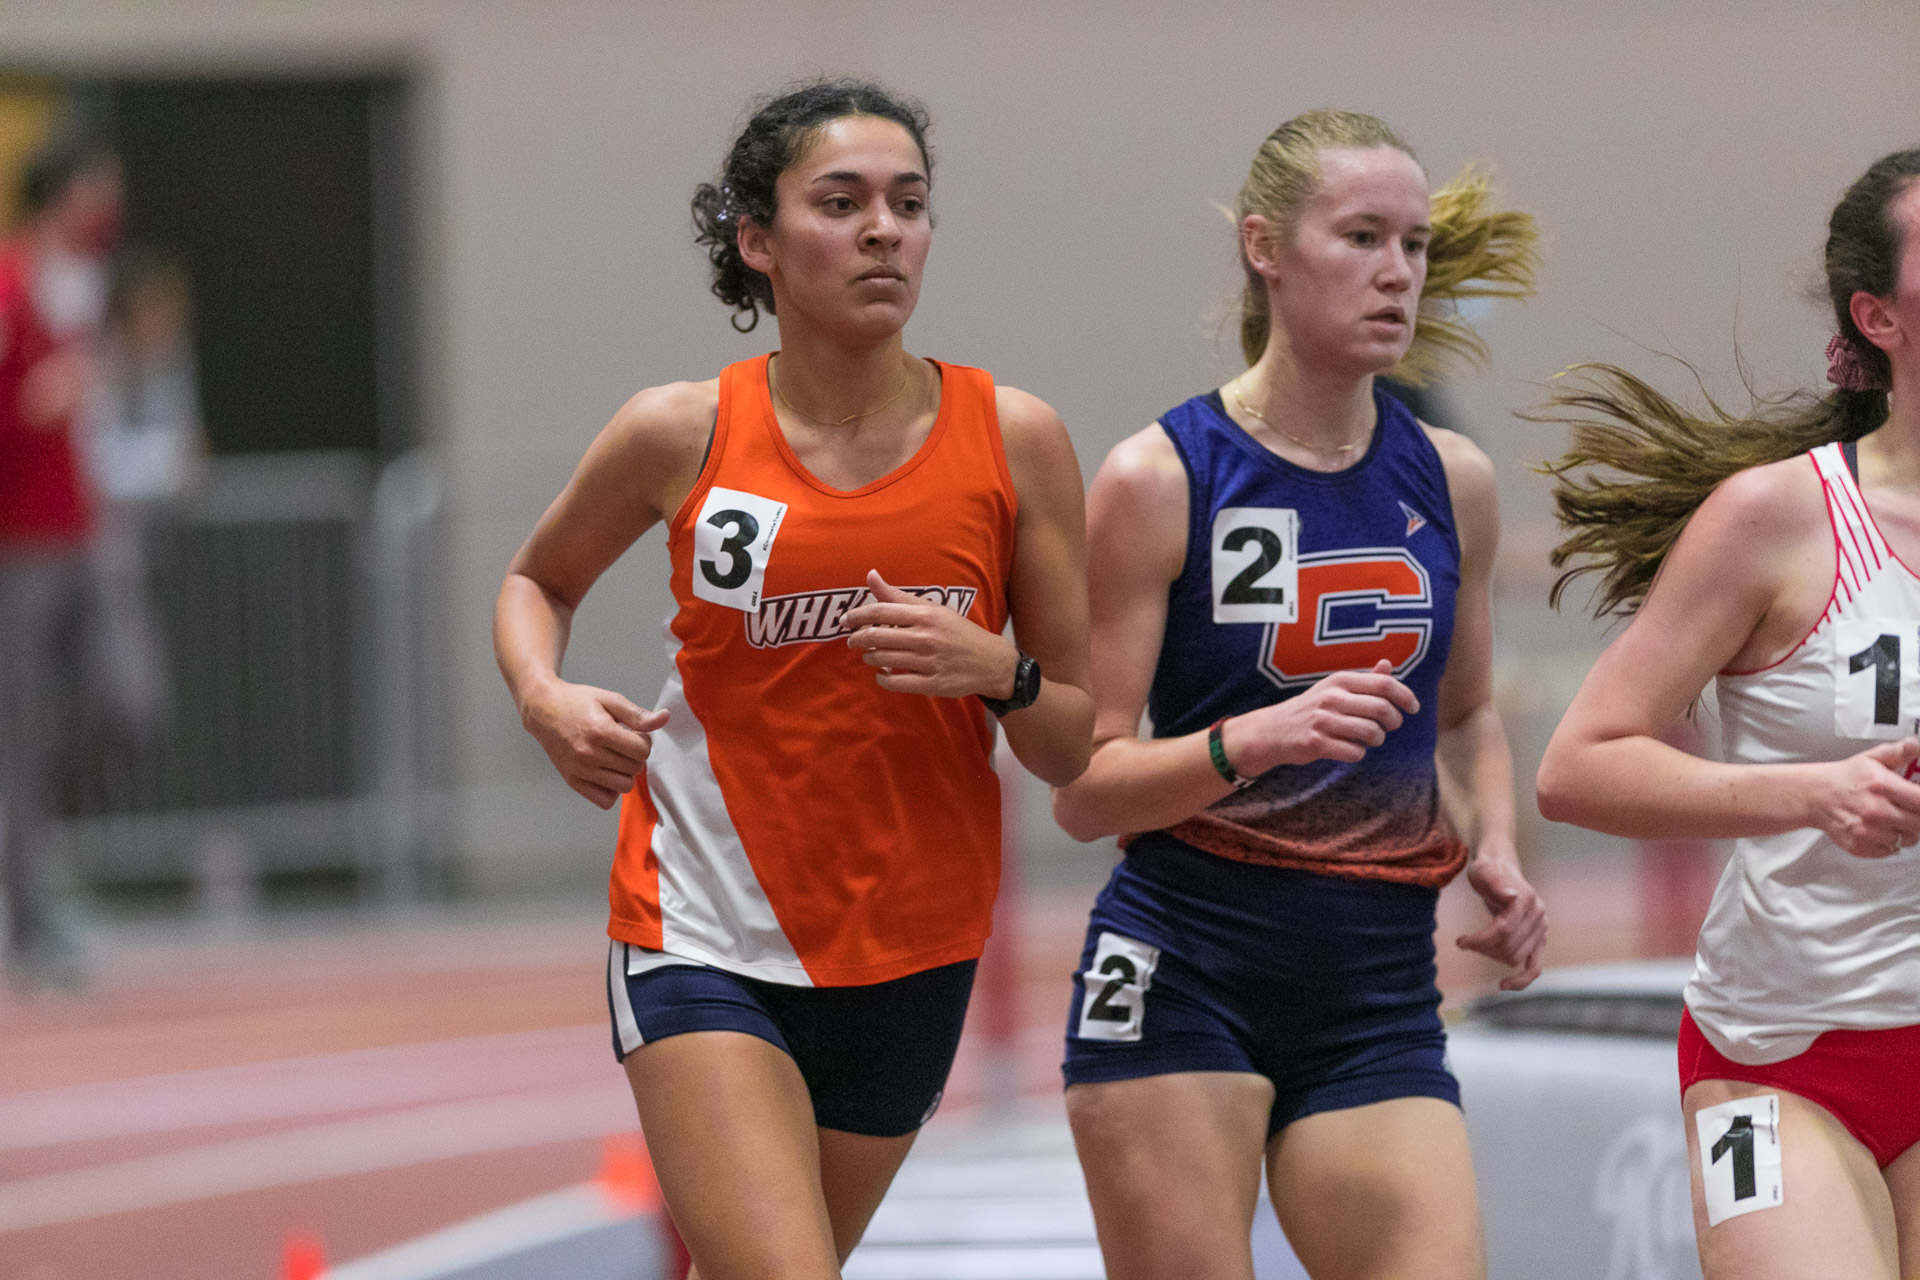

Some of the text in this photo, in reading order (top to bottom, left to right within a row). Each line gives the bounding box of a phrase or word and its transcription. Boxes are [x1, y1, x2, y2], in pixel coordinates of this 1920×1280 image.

[699, 509, 760, 590] 3
[1220, 526, 1284, 605] 2
[744, 585, 978, 649] WHEN
[1257, 547, 1433, 689] C
[1848, 633, 1901, 726] 1
[1086, 954, 1138, 1023] 2
[1711, 1114, 1757, 1202] 1
